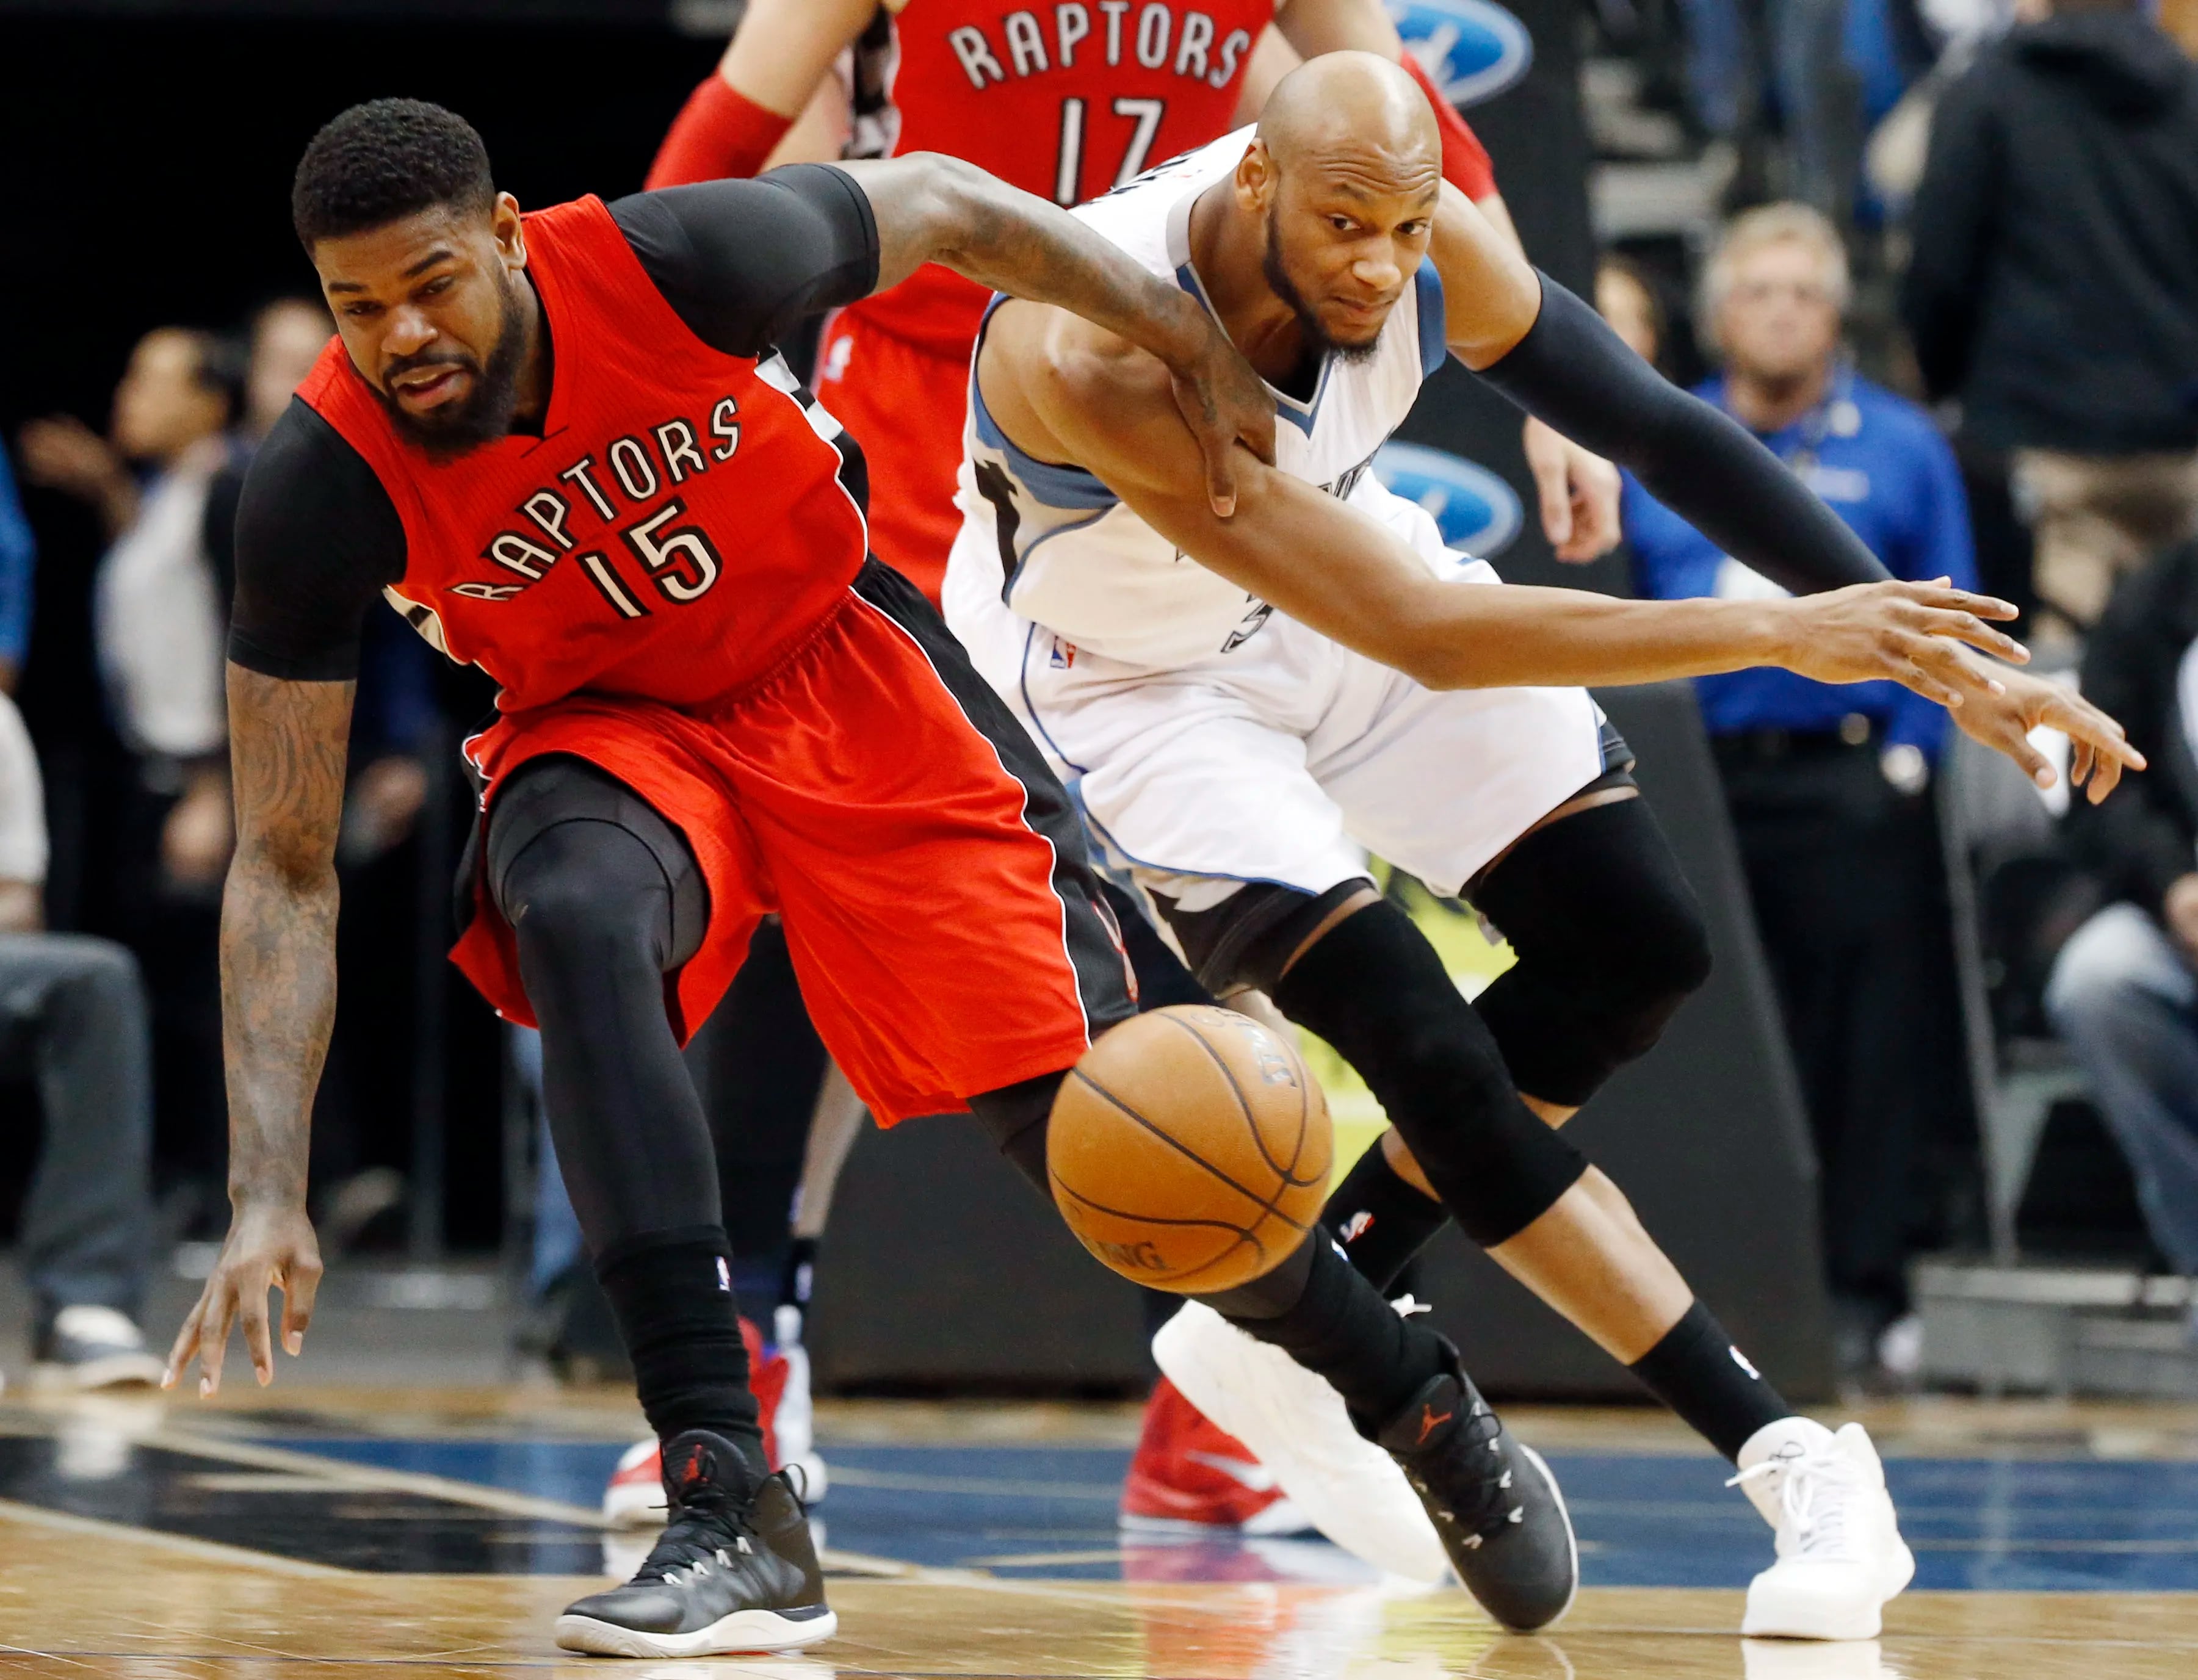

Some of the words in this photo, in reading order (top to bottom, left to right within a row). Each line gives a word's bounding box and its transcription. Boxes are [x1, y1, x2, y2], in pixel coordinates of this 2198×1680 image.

[949, 1, 1251, 89] RAPTORS
[1057, 97, 1165, 208] 17
[447, 394, 742, 602] RAPTORS
[576, 496, 723, 619] 15
